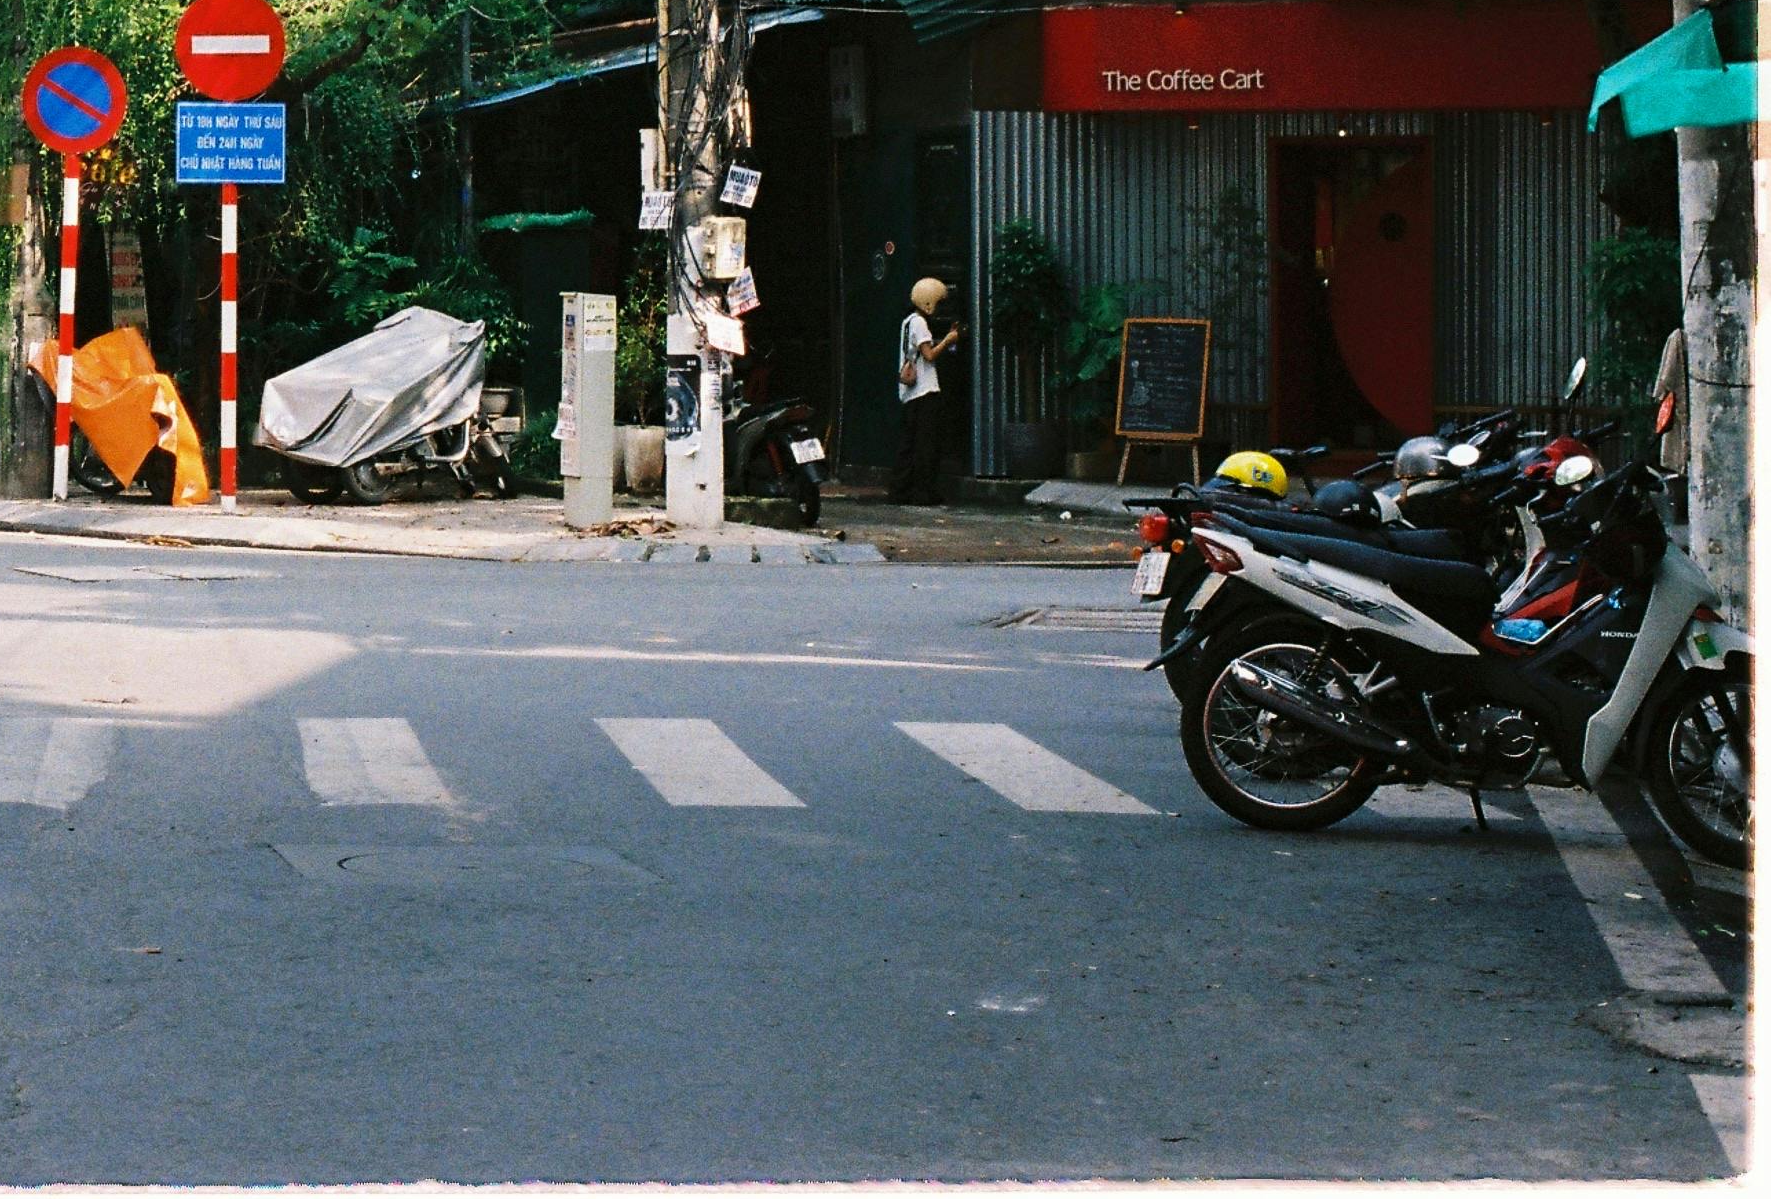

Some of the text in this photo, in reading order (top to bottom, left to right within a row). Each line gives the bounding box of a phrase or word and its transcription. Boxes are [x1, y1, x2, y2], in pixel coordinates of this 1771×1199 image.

[1102, 68, 1265, 92] The Coffee Cart
[215, 113, 240, 129] NGÀY
[244, 113, 263, 129] THỨ
[264, 113, 283, 129] SÁU
[196, 132, 216, 149] ĐẾN
[240, 133, 264, 149] NGÀY
[180, 153, 199, 170] CHỦ
[201, 154, 226, 172] NHẬT
[228, 155, 254, 170] HÀNG
